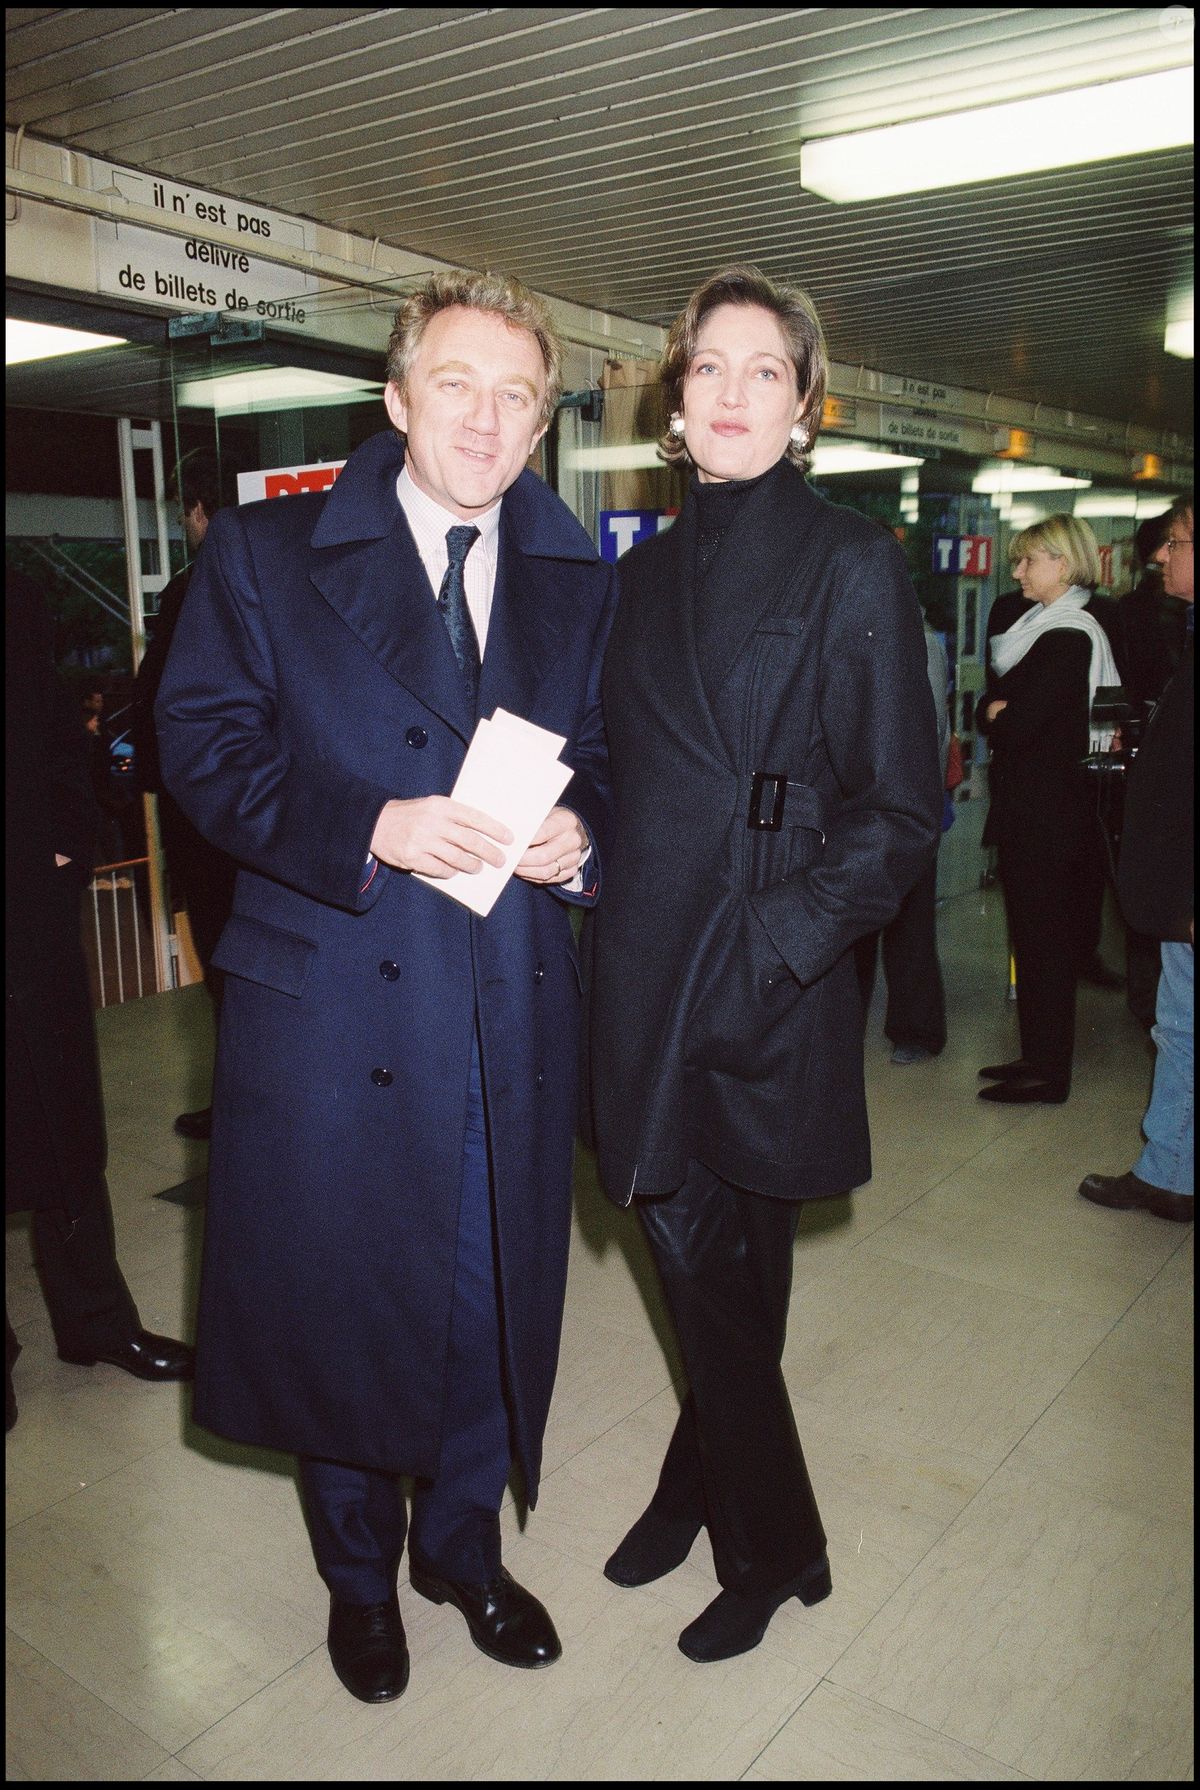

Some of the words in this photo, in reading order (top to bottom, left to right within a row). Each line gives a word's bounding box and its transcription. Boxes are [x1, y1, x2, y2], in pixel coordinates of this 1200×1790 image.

[153, 183, 165, 208] il
[237, 213, 271, 238] pas
[185, 239, 250, 273] délivré
[119, 264, 146, 291] de
[154, 271, 217, 306] billets
[225, 289, 249, 311] de
[256, 300, 306, 324] sortie
[265, 467, 343, 500] RT
